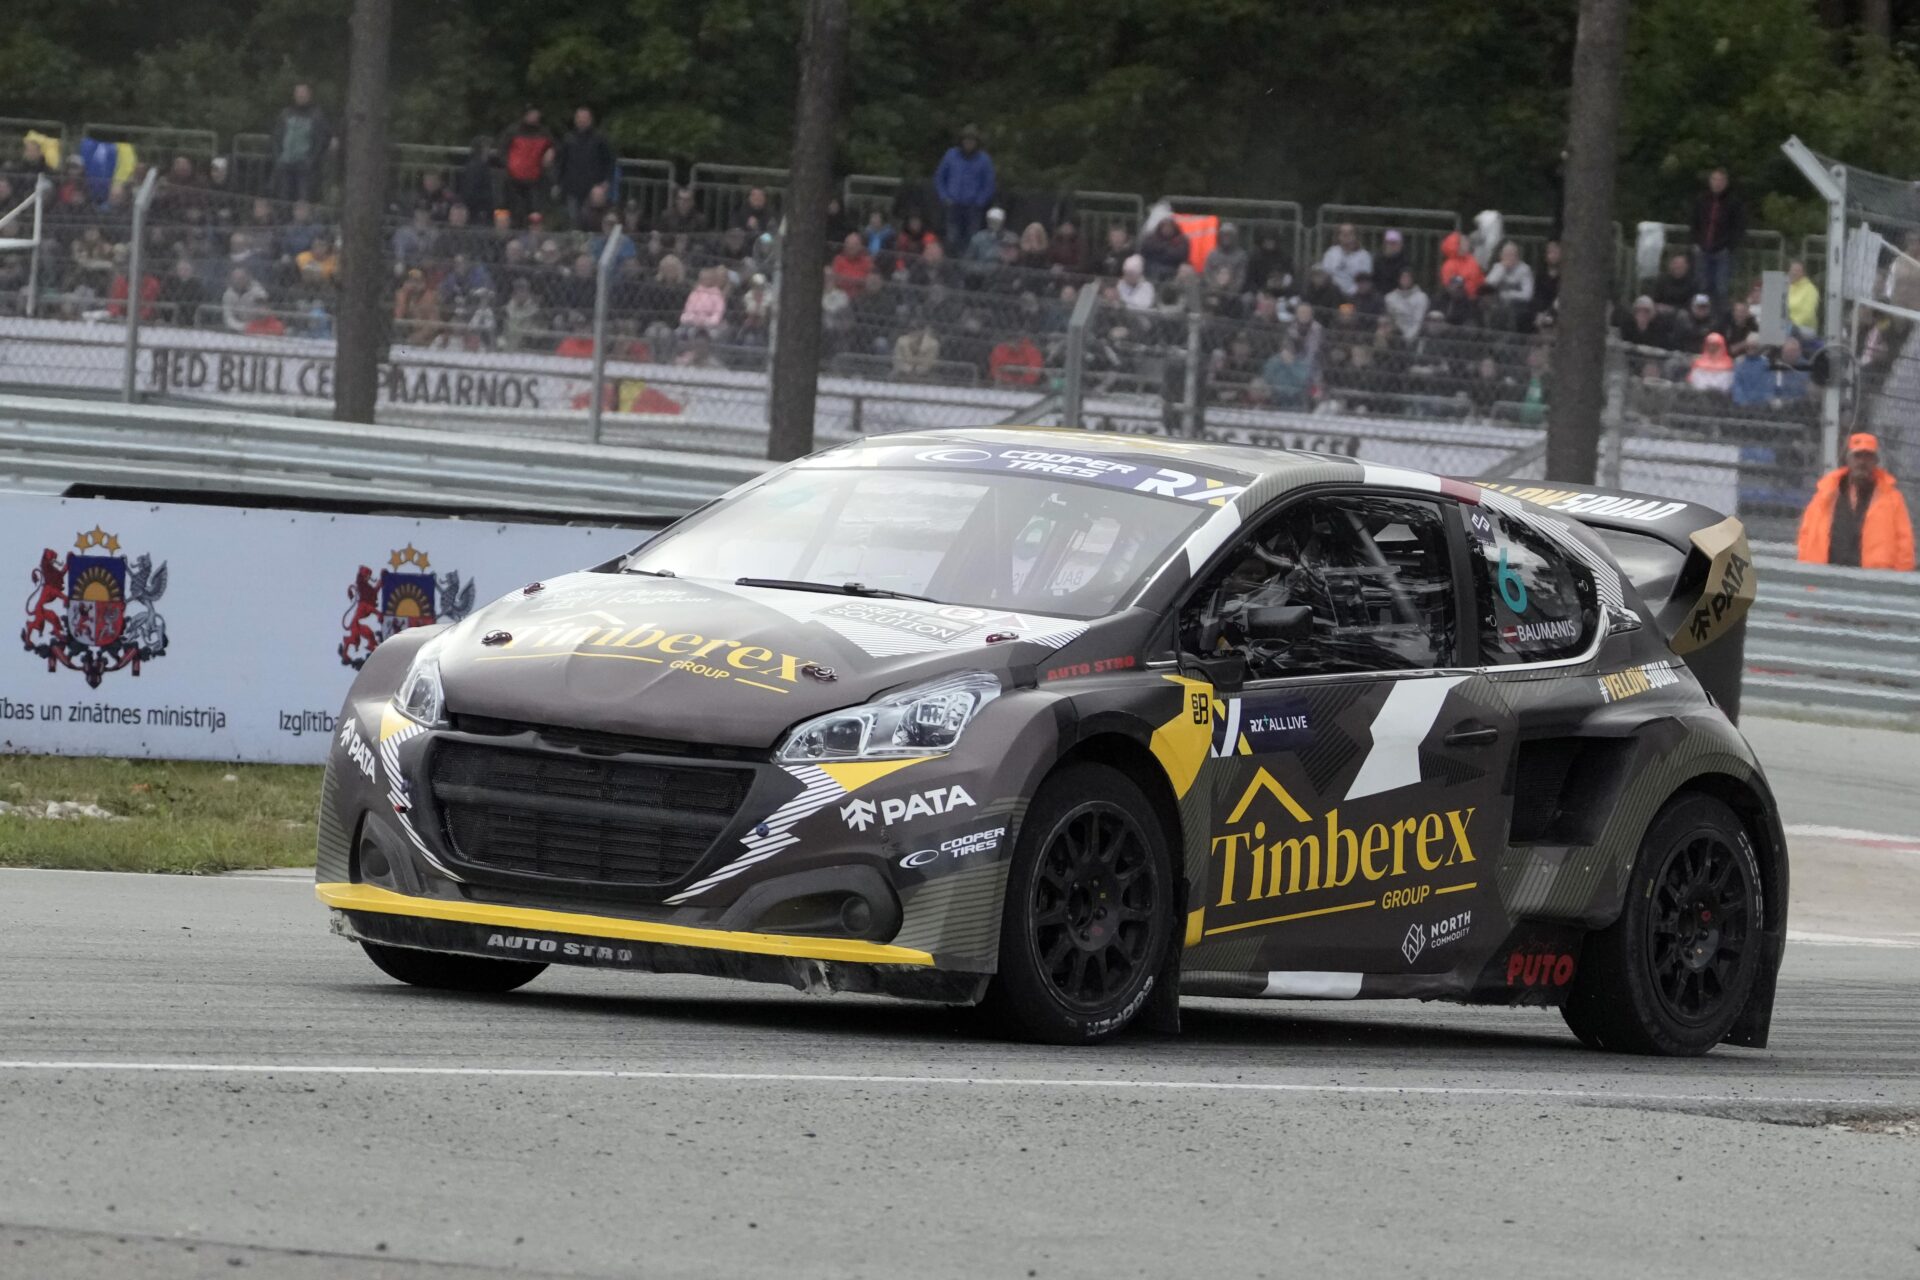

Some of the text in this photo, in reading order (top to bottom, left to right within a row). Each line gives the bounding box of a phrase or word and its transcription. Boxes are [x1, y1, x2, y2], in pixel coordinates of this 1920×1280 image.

[217, 354, 289, 393] BULL
[298, 359, 338, 398] CE
[999, 449, 1138, 475] COOPER
[1006, 459, 1102, 478] TIRES
[1498, 547, 1528, 614] 6
[1711, 552, 1750, 623] PATA
[828, 609, 957, 639] SOLUTION
[845, 603, 923, 622] GREAT
[1516, 619, 1577, 643] BAUMANIS
[669, 658, 731, 681] GROUP
[1047, 662, 1091, 681] AUTO
[1597, 660, 1680, 704] #YELLOWSQUAD
[40, 704, 63, 721] un
[68, 702, 142, 724] zinātnes
[147, 706, 227, 733] ministrija
[1269, 717, 1288, 732] ALL
[1287, 715, 1309, 731] LIVE
[348, 732, 376, 785] PATA
[881, 784, 977, 826] PATA
[940, 827, 1006, 851] COOPER
[951, 839, 997, 858] TIRES
[1211, 807, 1477, 908] Timberex
[1381, 884, 1431, 910] GROUP
[1431, 910, 1472, 938] NORTH
[486, 933, 558, 953] AUTO
[1431, 926, 1471, 949] COMMODITY
[1506, 952, 1575, 987] PUTO
